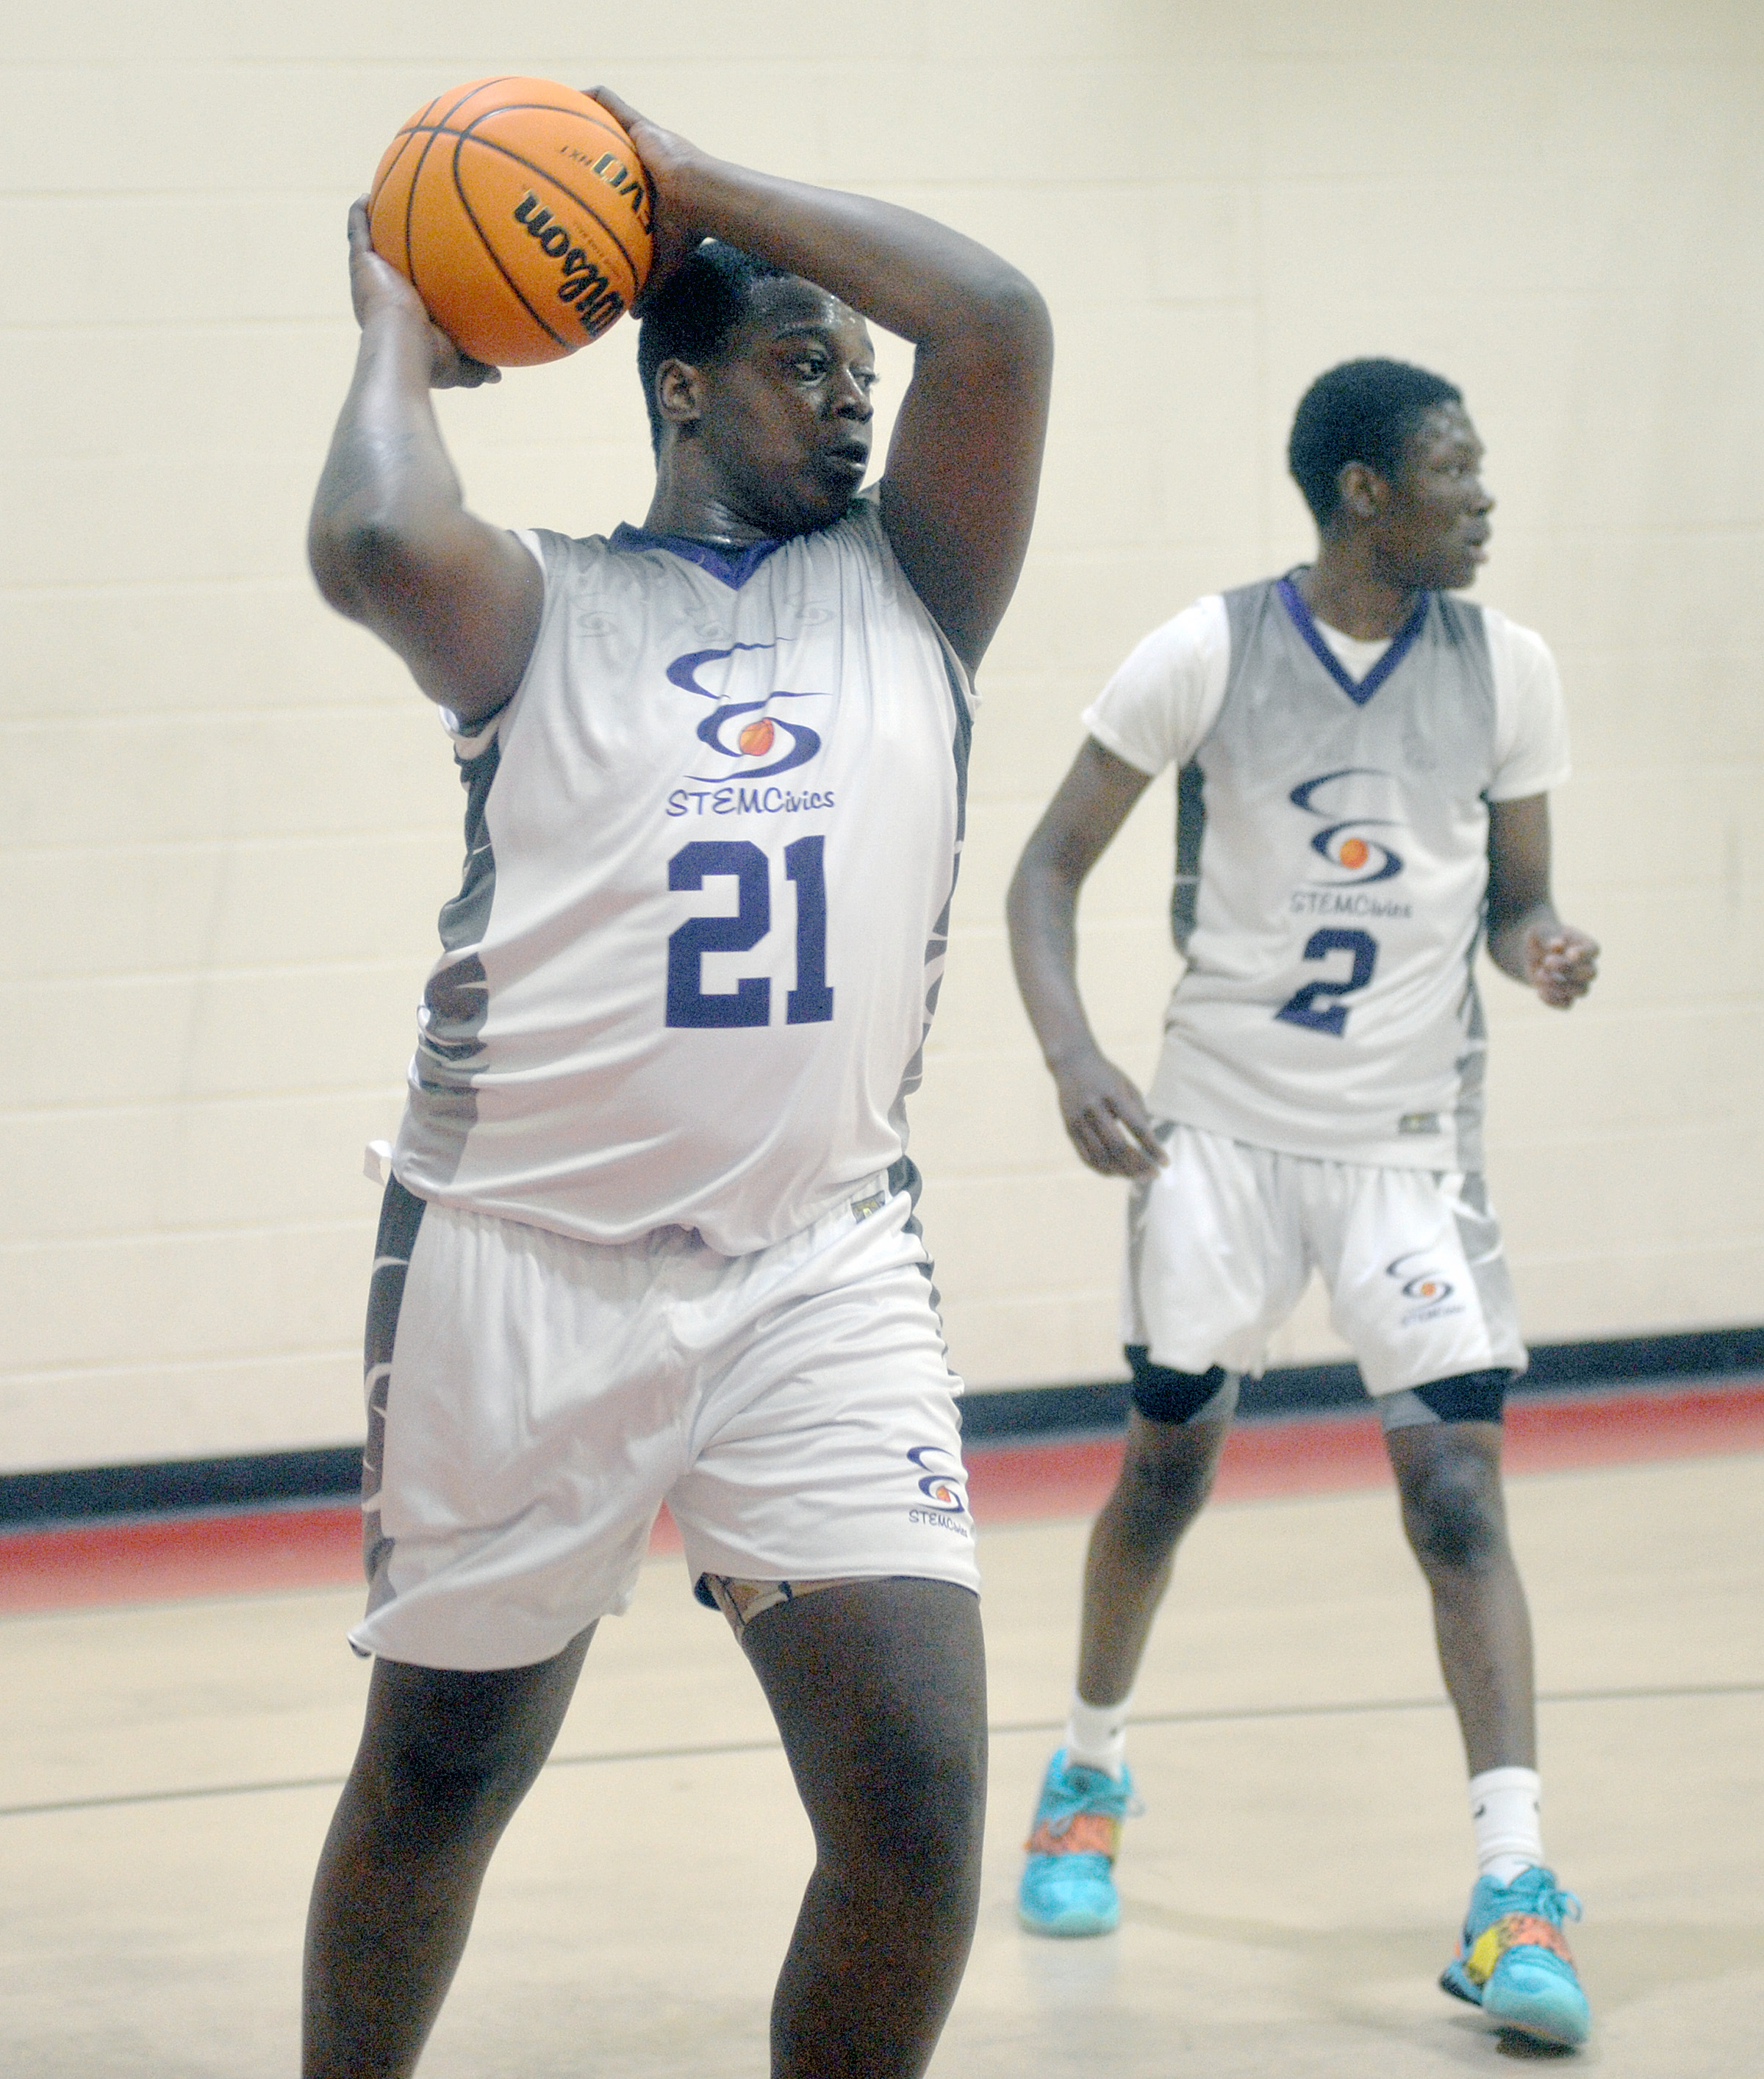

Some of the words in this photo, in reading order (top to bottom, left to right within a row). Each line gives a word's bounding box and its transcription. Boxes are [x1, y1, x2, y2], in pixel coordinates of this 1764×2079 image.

[513, 188, 625, 337] Wilson
[666, 787, 836, 817] STEMCivics
[666, 835, 834, 1029] 21
[1275, 927, 1379, 1038] 2
